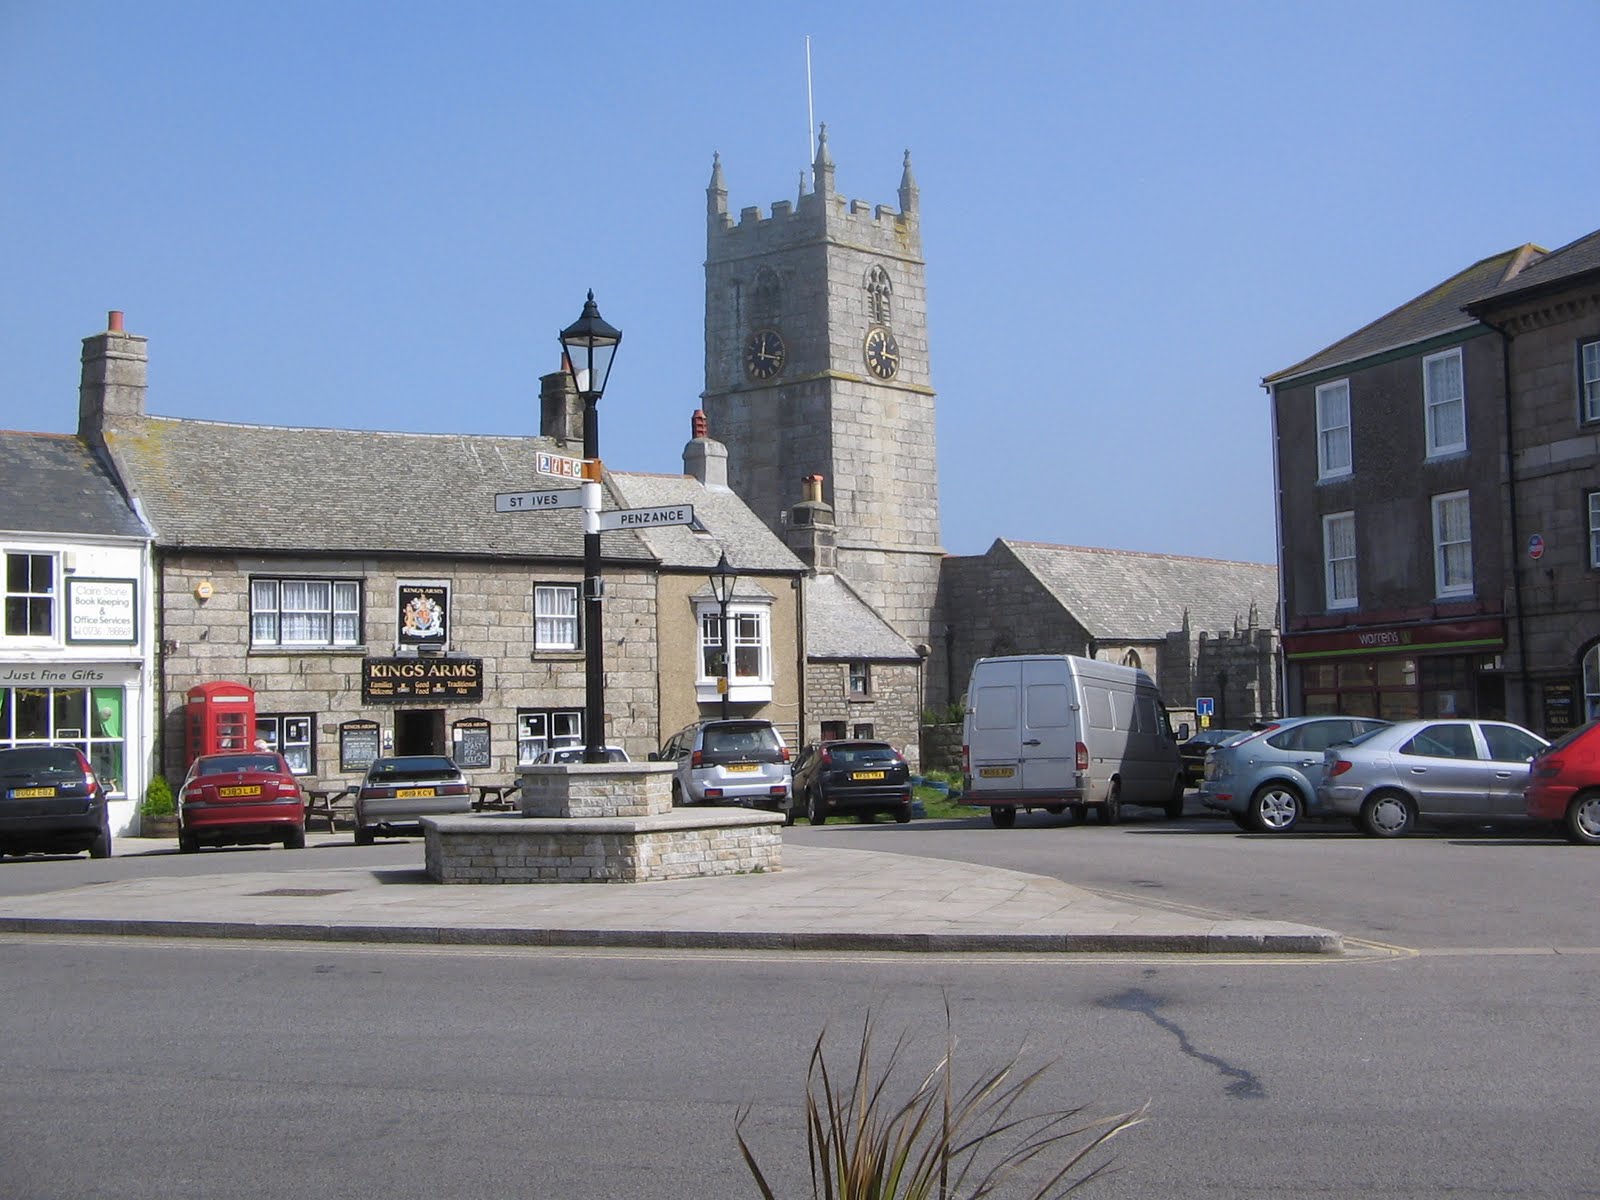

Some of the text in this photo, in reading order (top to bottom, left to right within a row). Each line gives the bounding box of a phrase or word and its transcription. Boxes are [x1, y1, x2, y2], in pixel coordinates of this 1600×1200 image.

[510, 495, 558, 507] ST IVES
[621, 510, 684, 524] PENZANCE
[75, 597, 130, 608] Book Keeping
[99, 606, 106, 616] &
[73, 616, 131, 625] Office Services
[1360, 632, 1399, 644] warrens
[3, 669, 104, 680] Just Fine Gifts
[370, 664, 477, 677] KINGS ARMS
